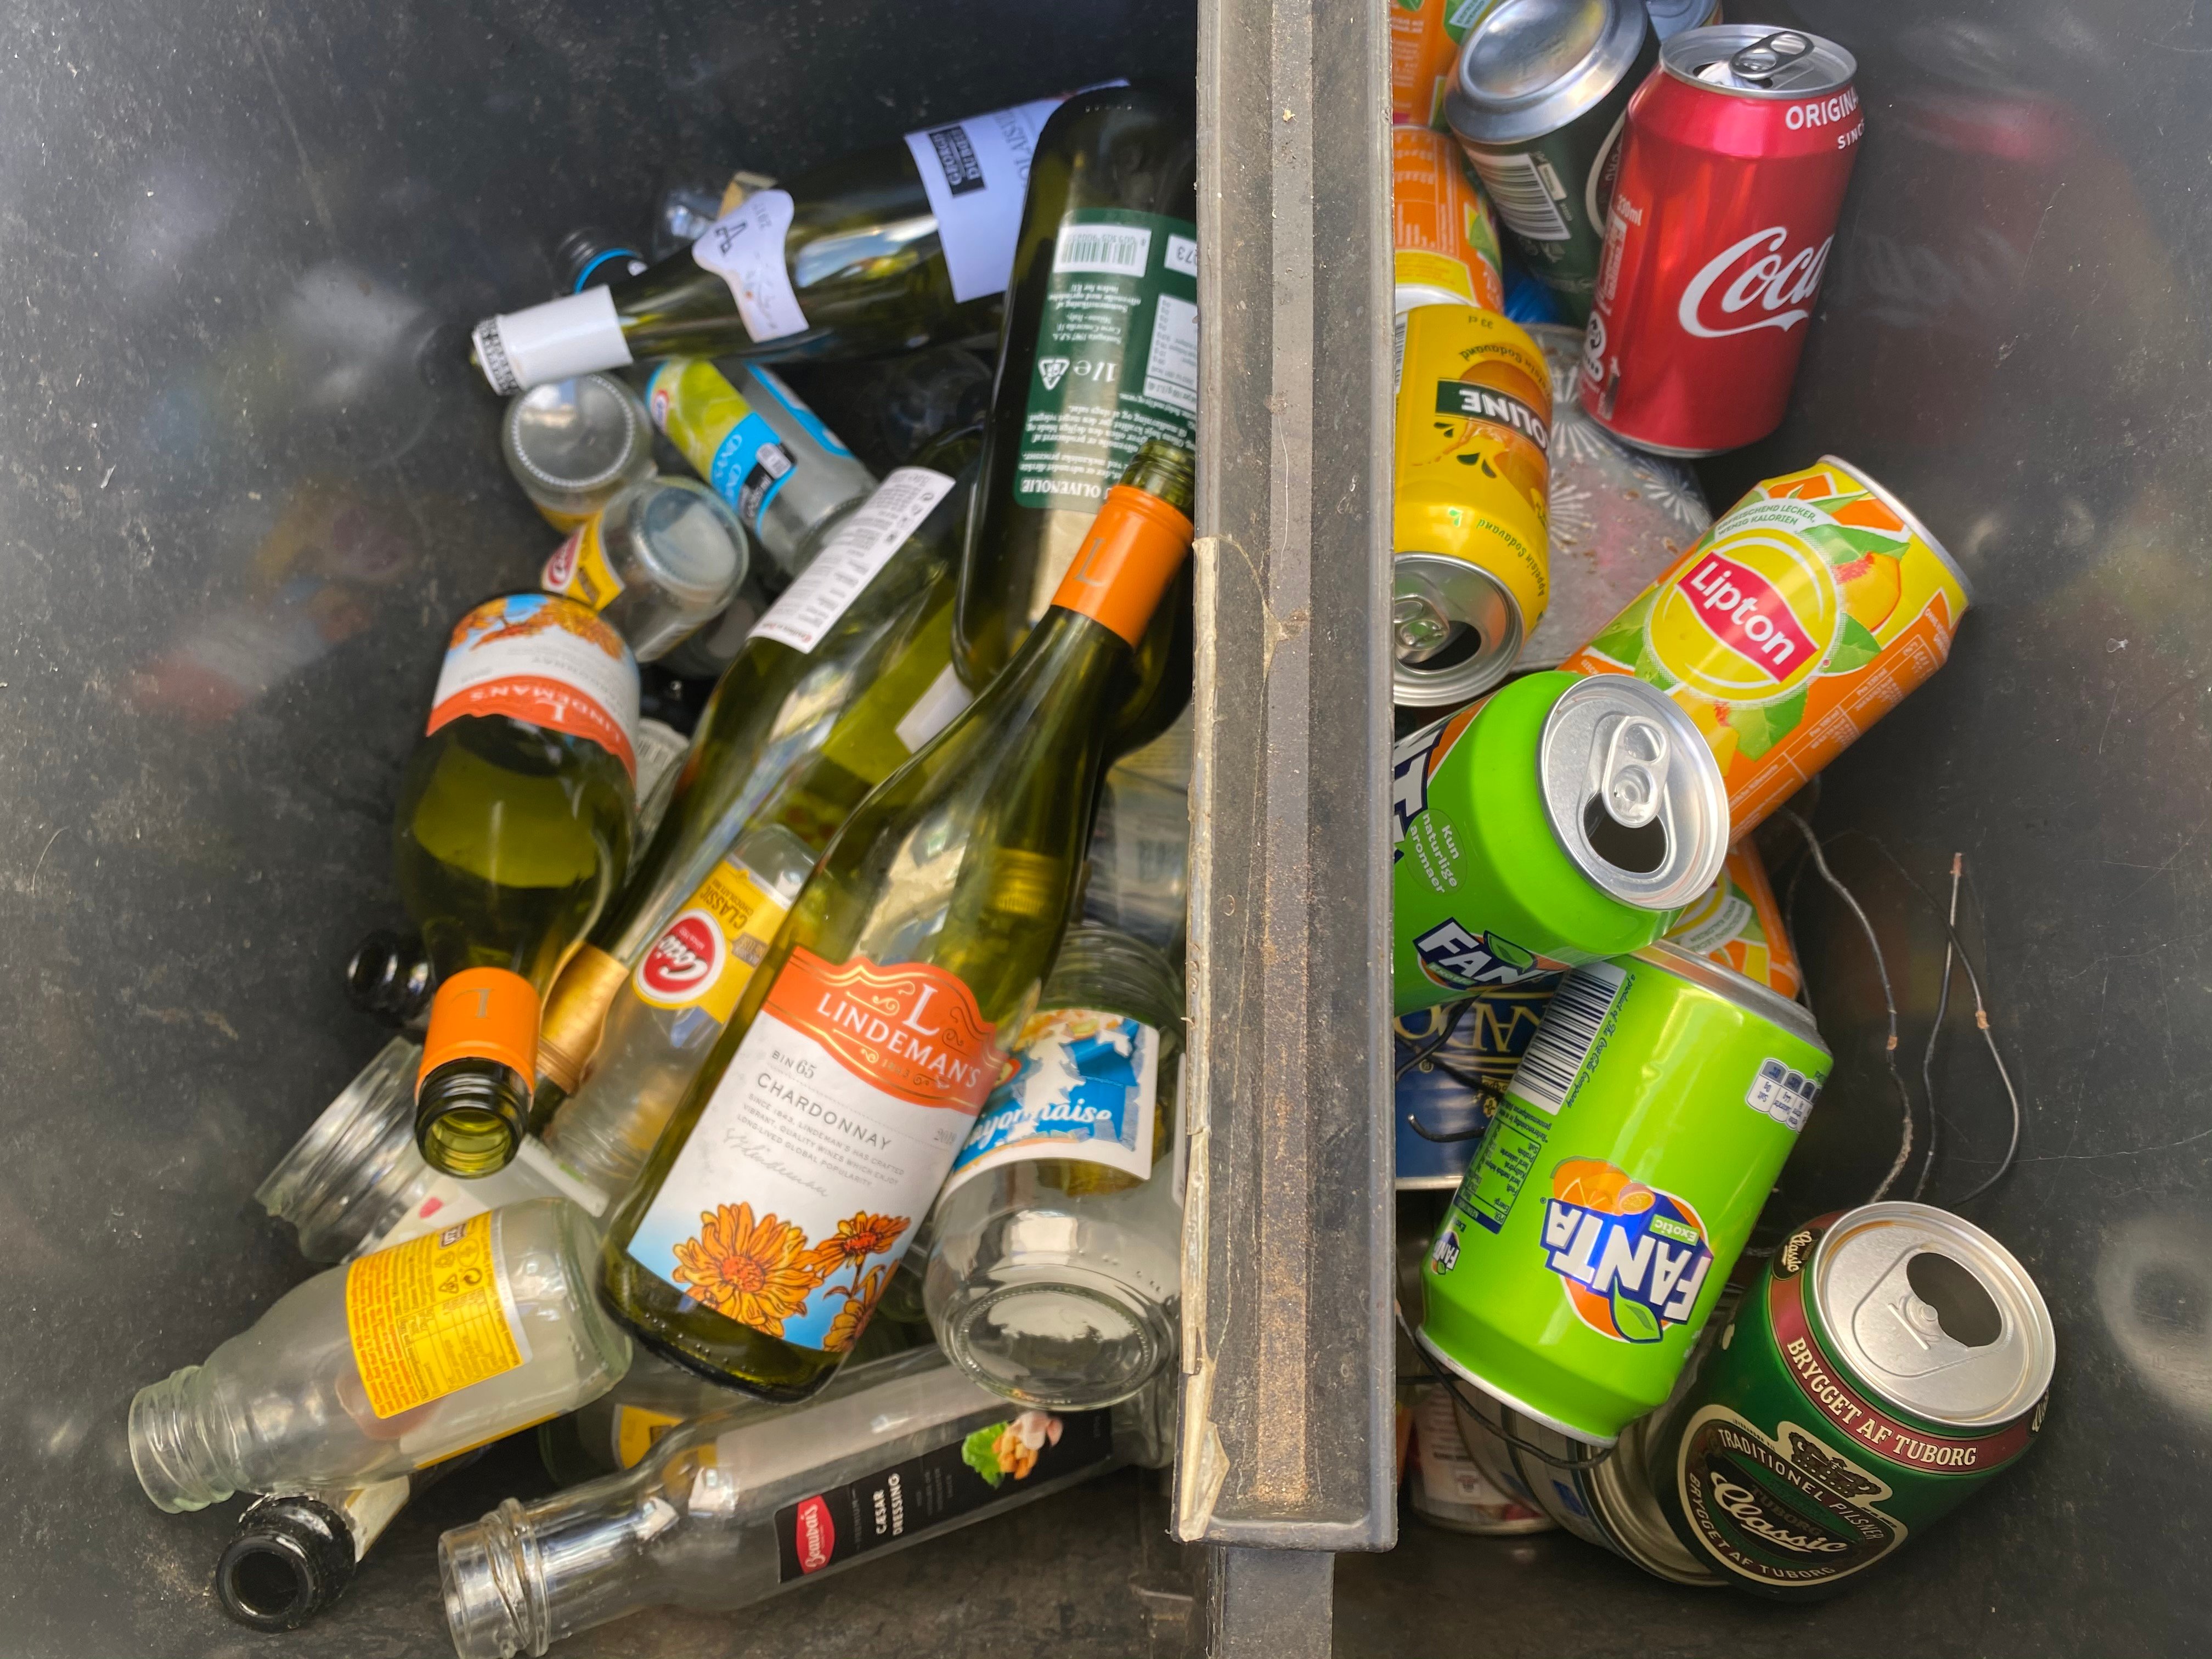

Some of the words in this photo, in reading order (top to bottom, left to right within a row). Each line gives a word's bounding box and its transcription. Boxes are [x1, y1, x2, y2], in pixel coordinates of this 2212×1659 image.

[1466, 314, 1478, 325] cl
[1479, 318, 1493, 329] 33
[1020, 478, 1102, 498] OLIVENOLIE
[1475, 518, 1526, 557] Sodavand
[1779, 505, 1817, 524] LECKER,
[1525, 552, 1545, 596] Appelsin
[1691, 563, 1801, 667] Lipton
[1410, 825, 1444, 891] aromaer
[1423, 813, 1457, 887] naturlige
[1442, 825, 1458, 859] Kun
[698, 883, 749, 932] CLASSIC
[654, 933, 709, 980] Cocio
[901, 982, 956, 1041] L
[1607, 1008, 1621, 1023] of
[1616, 978, 1633, 1011] product
[814, 991, 983, 1090] LINDEMAN'S
[1601, 1019, 1618, 1038] The
[770, 1049, 795, 1069] BIN
[793, 1057, 819, 1081] 65
[755, 1070, 892, 1152] CHARDONNAY
[1562, 1069, 1593, 1110] Company
[735, 1114, 783, 1146] LONG-LIVED
[783, 1141, 820, 1163] GLOBAL
[819, 1158, 873, 1189] POPULARITY
[747, 1092, 773, 1111] SINCE
[797, 1121, 852, 1153] LINDEMAN'S
[851, 1148, 870, 1161] HAS
[870, 1155, 905, 1178] CRAFTED
[777, 1124, 817, 1149] QUALITY
[816, 1144, 845, 1163] WINES
[845, 1157, 874, 1176] WHICH
[873, 1170, 900, 1188] ENJOY
[1655, 1220, 1698, 1244] Exotic
[1786, 1231, 1812, 1273] Classic
[1545, 1201, 1712, 1322] FANTA
[1787, 1337, 1863, 1425] BRYGGET
[1857, 1418, 1893, 1445] AF
[1893, 1434, 1977, 1466] TUBORG
[887, 1471, 904, 1535] DRESSING
[1718, 1429, 1826, 1502] TRADITIONEL
[1829, 1502, 1885, 1542] PILSNER
[873, 1489, 887, 1534] CÆSAR
[1688, 1474, 1730, 1549] BRYGGET
[1728, 1549, 1754, 1568] AF
[1759, 1564, 1835, 1578] TUBORG
[1711, 1471, 1847, 1553] Classic
